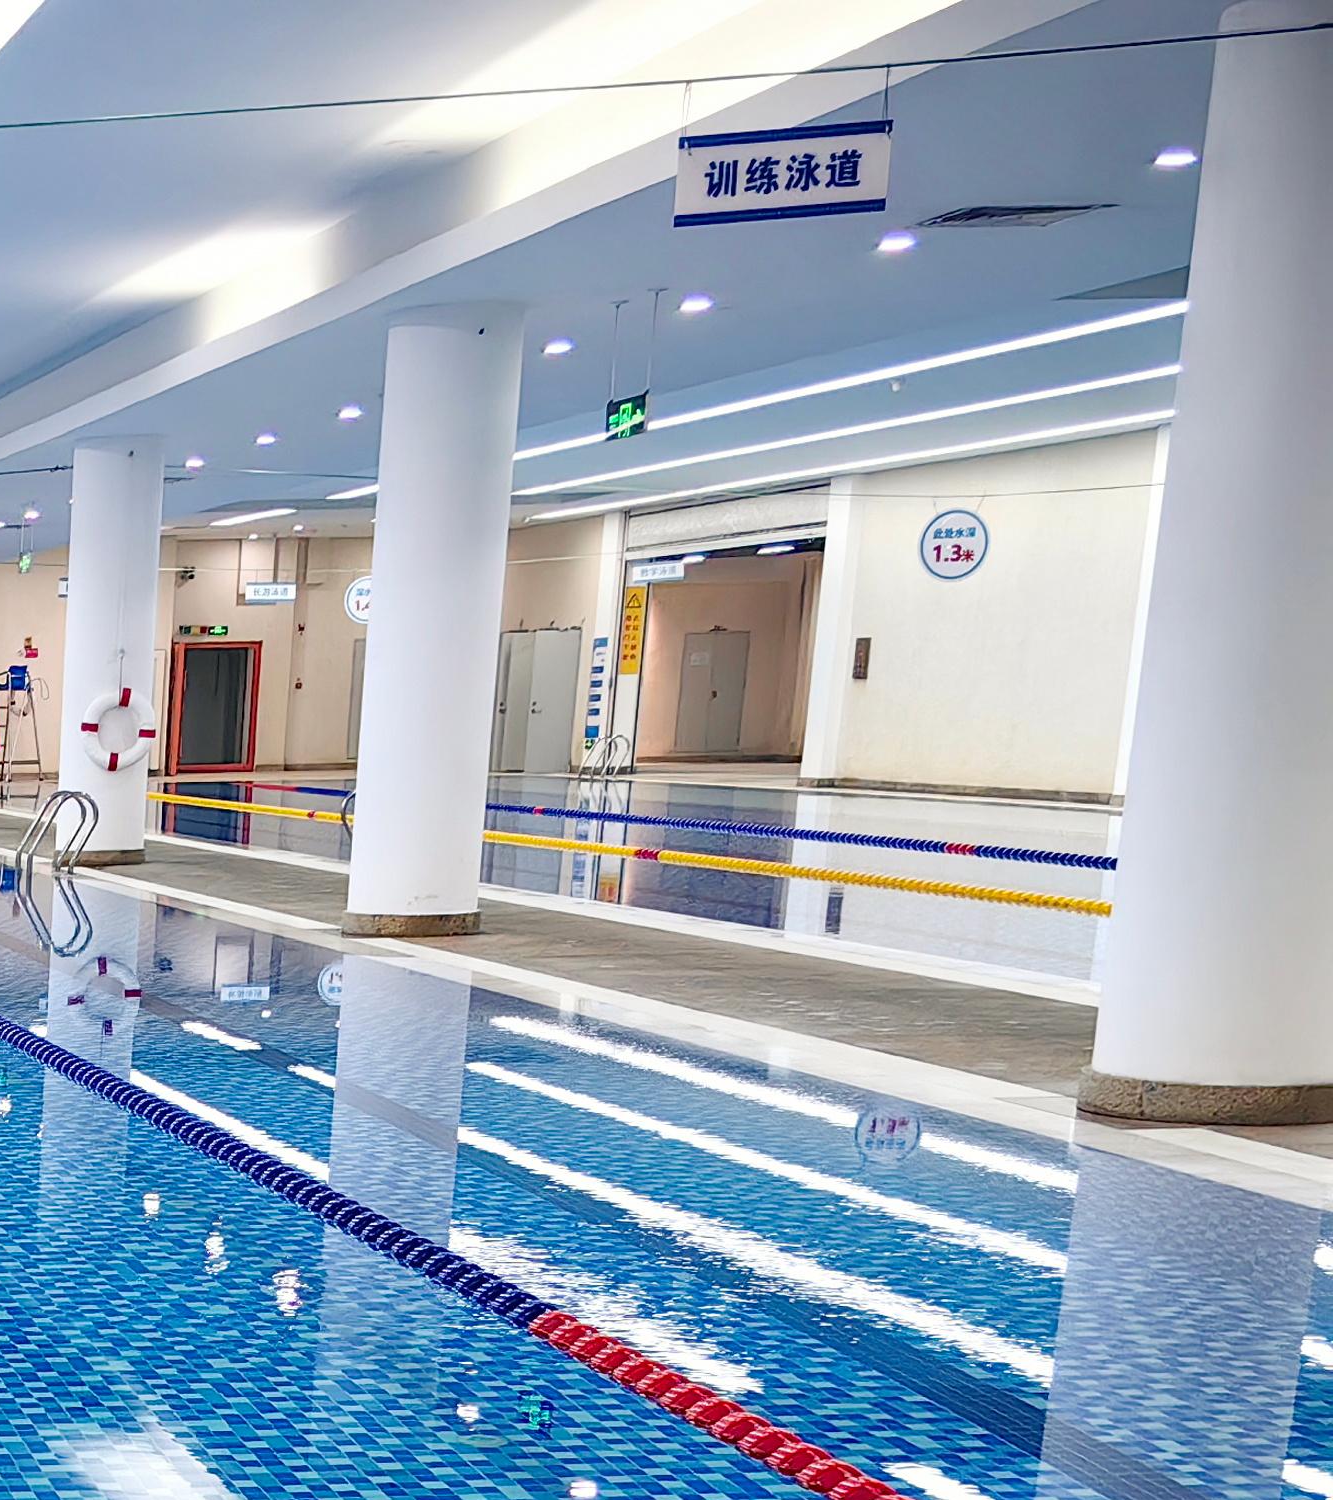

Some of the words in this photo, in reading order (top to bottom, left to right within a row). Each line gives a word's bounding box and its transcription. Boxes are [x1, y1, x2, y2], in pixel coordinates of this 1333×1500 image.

[704, 149, 863, 198] 训练泳道
[933, 544, 975, 562] 1.3米
